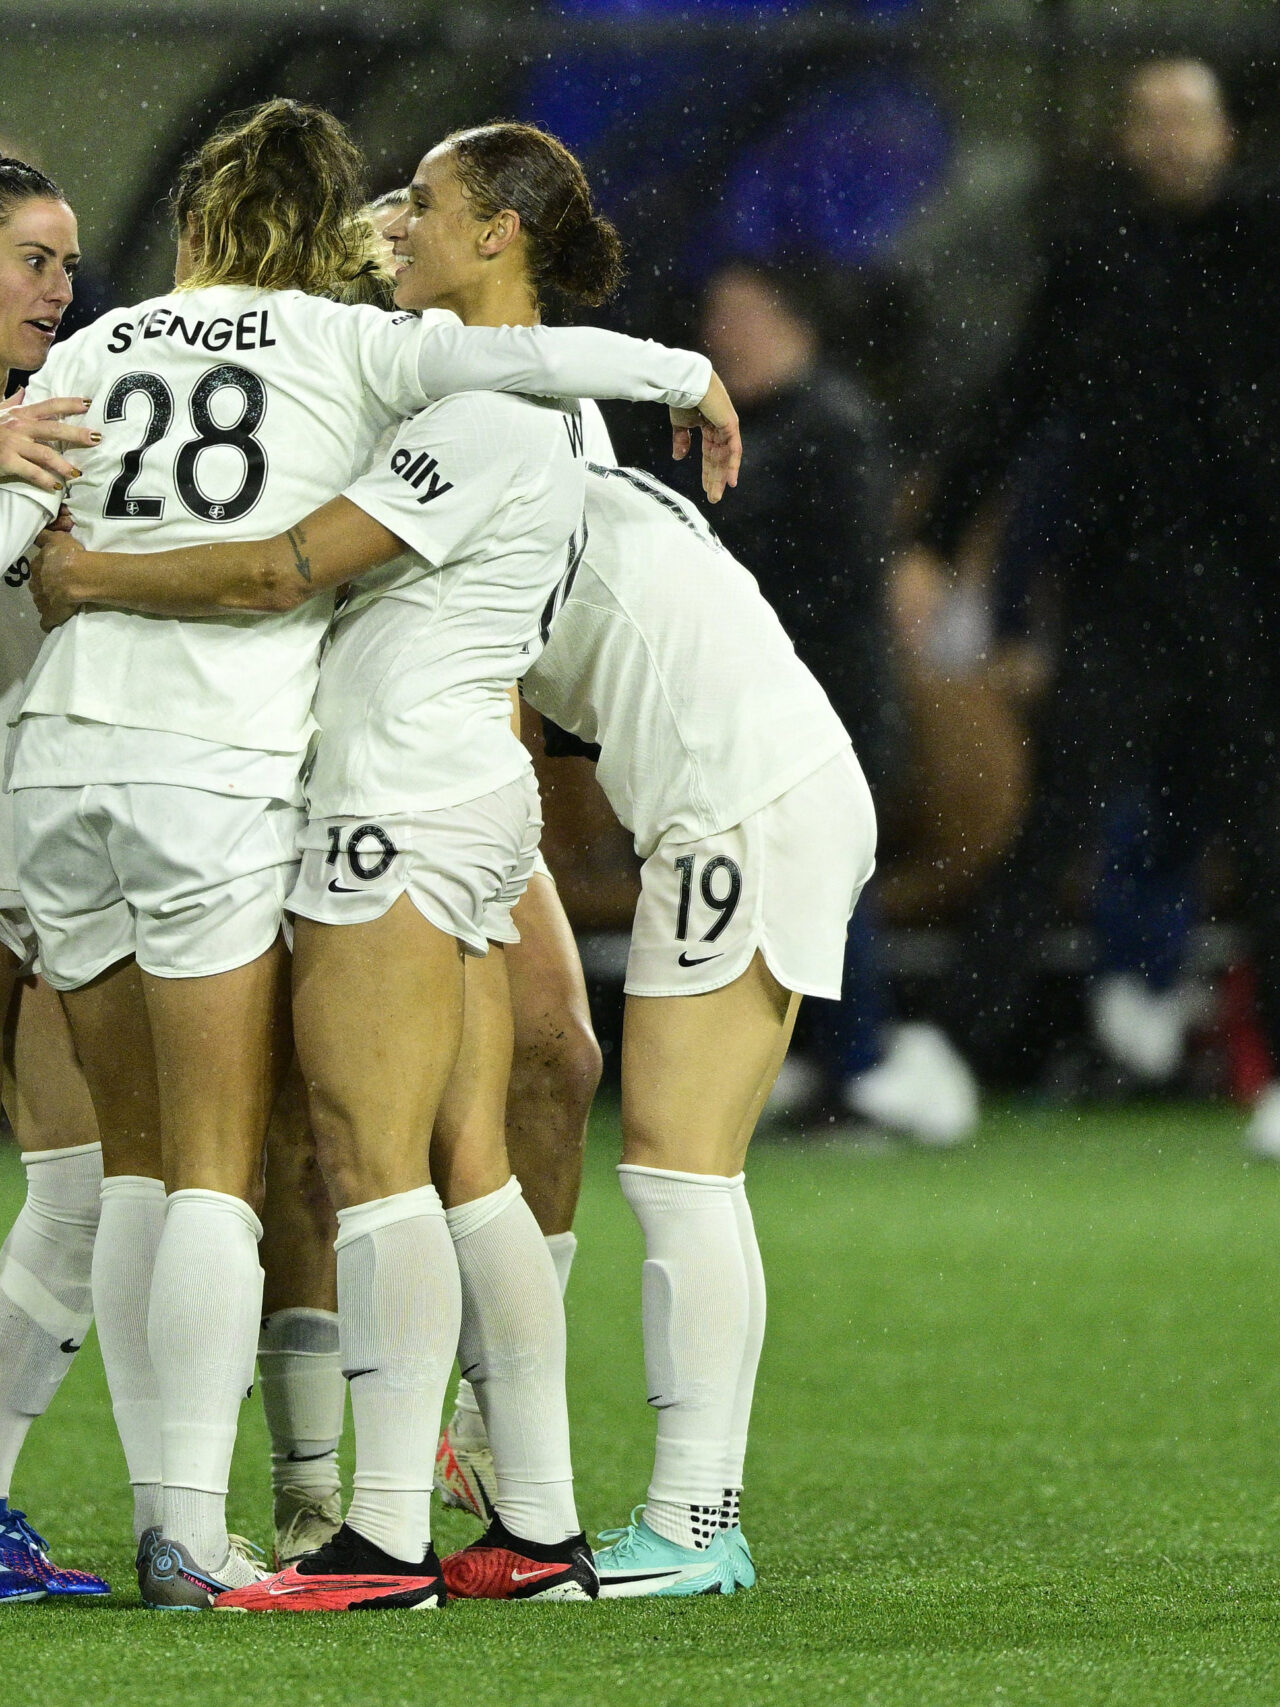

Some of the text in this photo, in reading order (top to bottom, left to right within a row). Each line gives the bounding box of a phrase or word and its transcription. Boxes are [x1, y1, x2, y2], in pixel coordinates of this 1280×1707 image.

[102, 363, 269, 524] 28
[390, 448, 455, 505] ally
[325, 823, 399, 881] 10
[673, 853, 742, 944] 19
